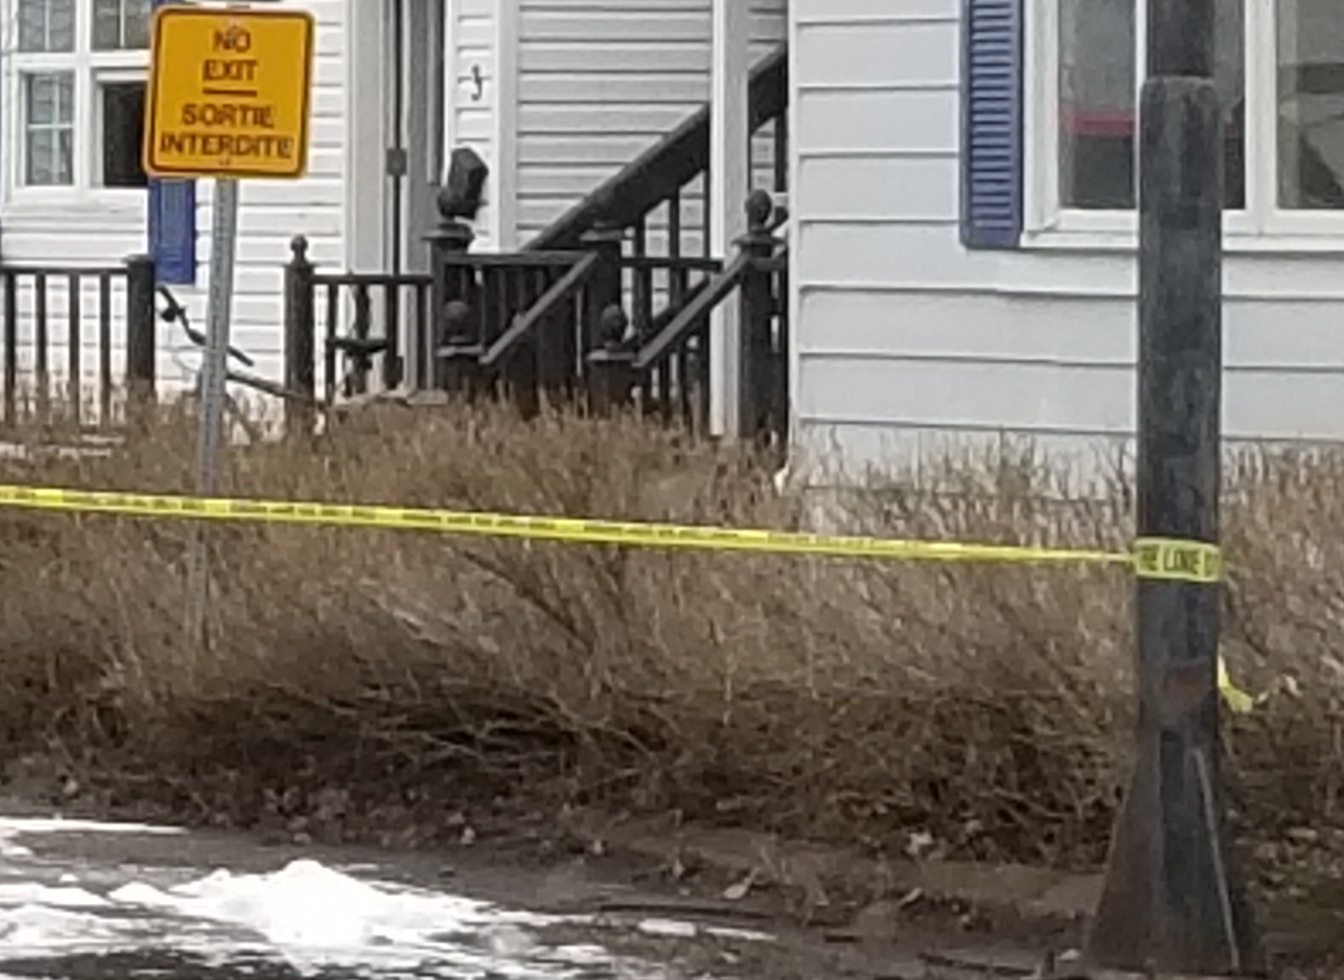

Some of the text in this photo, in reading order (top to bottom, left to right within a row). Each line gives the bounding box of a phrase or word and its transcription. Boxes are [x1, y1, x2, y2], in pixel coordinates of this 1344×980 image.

[213, 28, 252, 54] NO
[202, 58, 259, 82] EXIT
[181, 102, 275, 129] SORTIE
[159, 131, 295, 160] INTERDITE
